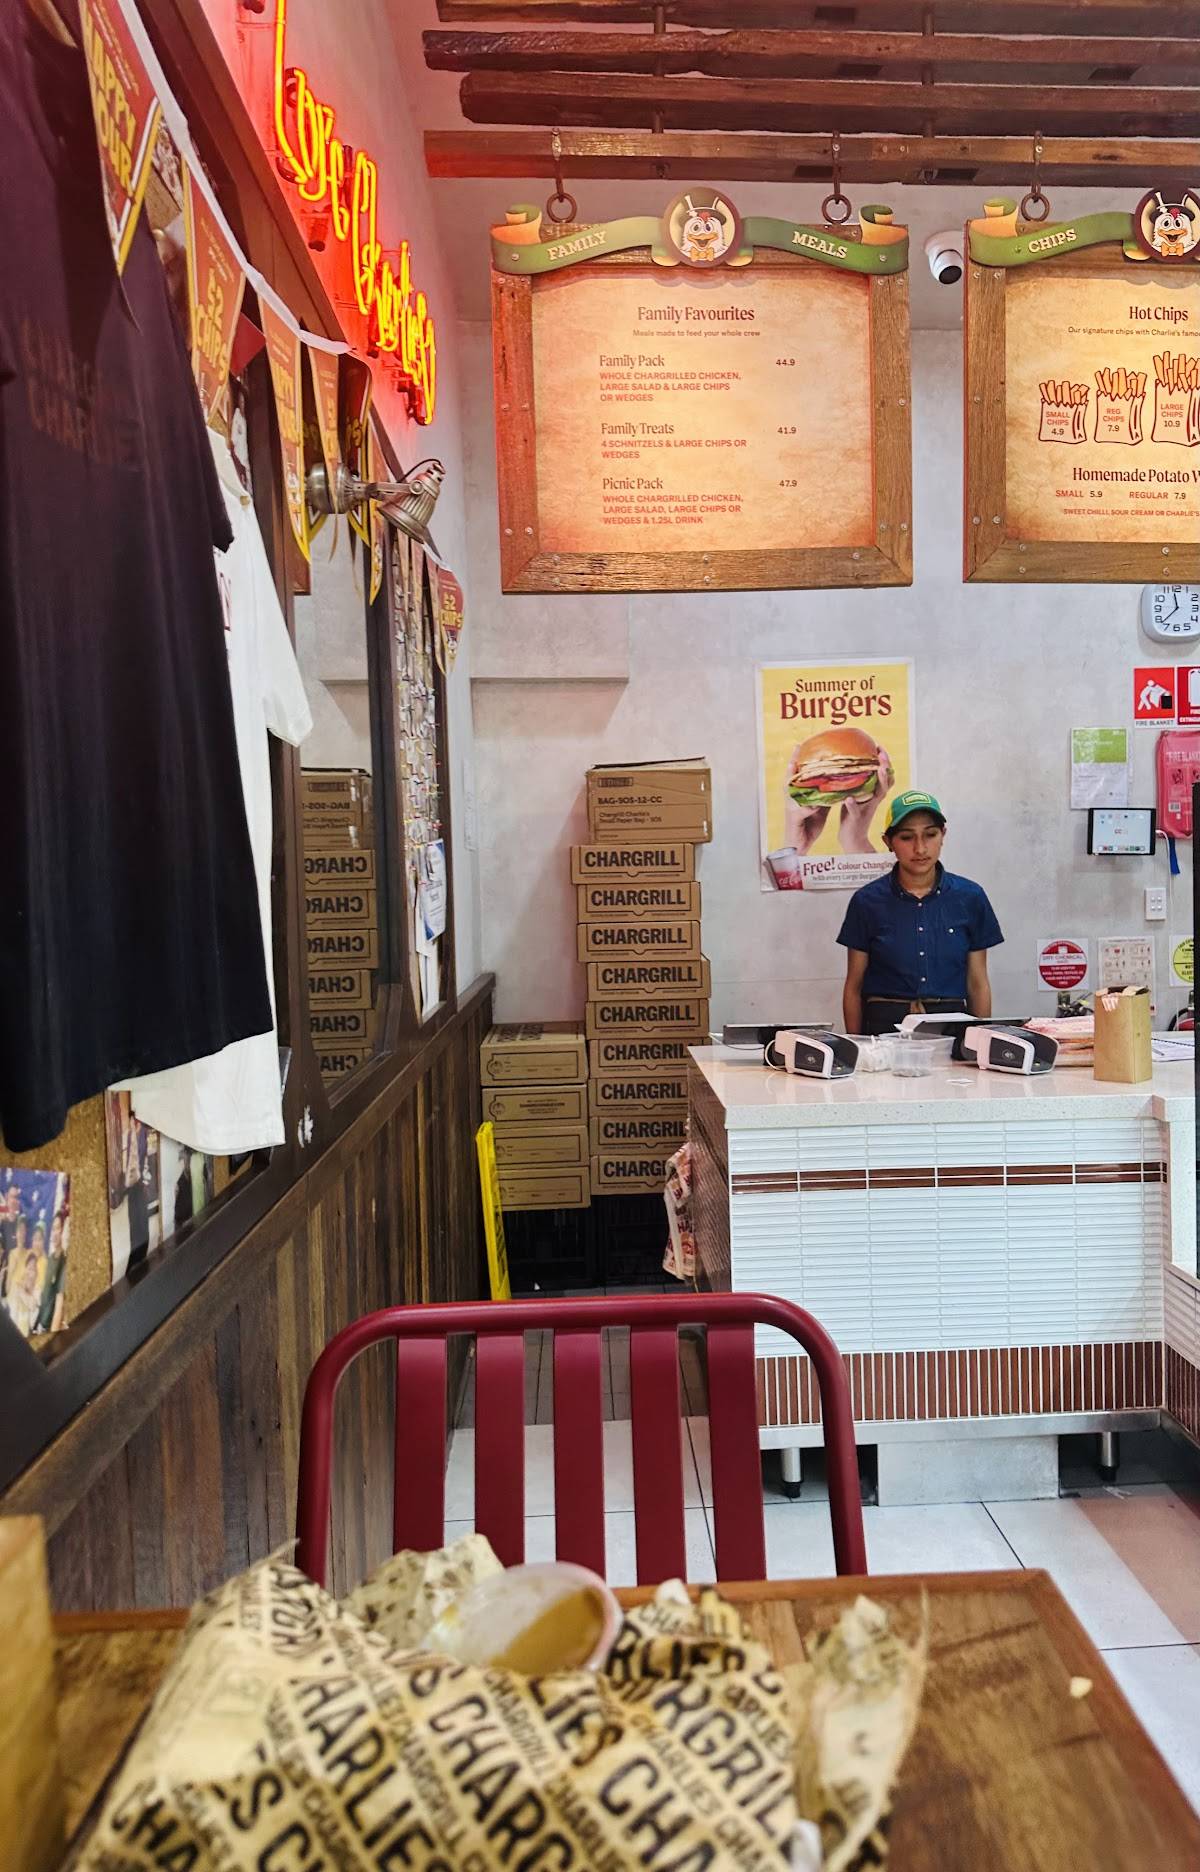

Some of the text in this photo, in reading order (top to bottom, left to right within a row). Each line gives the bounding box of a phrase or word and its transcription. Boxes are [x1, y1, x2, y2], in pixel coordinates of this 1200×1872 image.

[547, 231, 848, 260] FAMILY MEALS
[1028, 228, 1077, 253] CHIPS
[637, 306, 755, 324] Family Favourites
[1129, 306, 1189, 325] Hot Chips
[1082, 327, 1114, 335] signature
[1115, 328, 1134, 336] chips
[1135, 328, 1151, 336] with
[1151, 328, 1180, 337] Charlie's
[600, 354, 665, 369] Family Pack
[600, 371, 743, 381] WHOLE CHARGRILLED CHICKEN,
[600, 382, 730, 391] LARGE SALAD & LARGE CHIPS
[1107, 424, 1120, 432] 7.9
[1164, 420, 1181, 428] 10.9
[601, 422, 675, 437] Family Treats
[777, 426, 797, 434] 41.9
[608, 440, 664, 448] SCHNITZELS
[705, 439, 732, 447] CHIPS
[734, 439, 747, 447] OR
[601, 451, 640, 459] WEDGES
[1073, 467, 1146, 482] Homemade
[1148, 469, 1190, 483] Potato
[602, 477, 664, 490] Picnic Pack
[779, 479, 798, 487] 47.9
[602, 494, 744, 503] WHOLE CHARGRILLED CHICKEN,
[1055, 490, 1187, 500] SMALL 5.9 REGULAR 7.9
[603, 506, 633, 514] LARGE
[634, 506, 666, 514] SALAD,
[668, 505, 697, 513] LARGE
[603, 517, 641, 525] WEDGES
[651, 516, 673, 524] 1.25L
[675, 516, 703, 524] DRINK
[1172, 585, 1182, 593] 12
[1155, 594, 1165, 603] 10
[1191, 593, 1199, 601] 2
[1154, 604, 1162, 613] 9
[1192, 604, 1199, 613] 3
[1155, 615, 1162, 623] 8
[1190, 615, 1198, 623] 4
[1163, 623, 1170, 631] 7
[1173, 623, 1181, 632] 6
[1183, 622, 1191, 631] 5
[795, 675, 876, 693] Summer of
[780, 691, 892, 725] Burgers
[584, 850, 681, 868] CHARGRILL
[803, 857, 895, 876] Free! Colour Changin
[590, 889, 686, 907] CHARGRILL
[591, 928, 687, 946] CHARGRILL
[602, 967, 697, 984] CHARGRILL
[600, 1005, 695, 1023] CHARGRILL
[603, 1043, 693, 1061] CHARGRIL
[601, 1083, 688, 1100] CHARGRIL
[603, 1122, 688, 1139] CHARGRIL
[604, 1160, 668, 1178] CHARG
